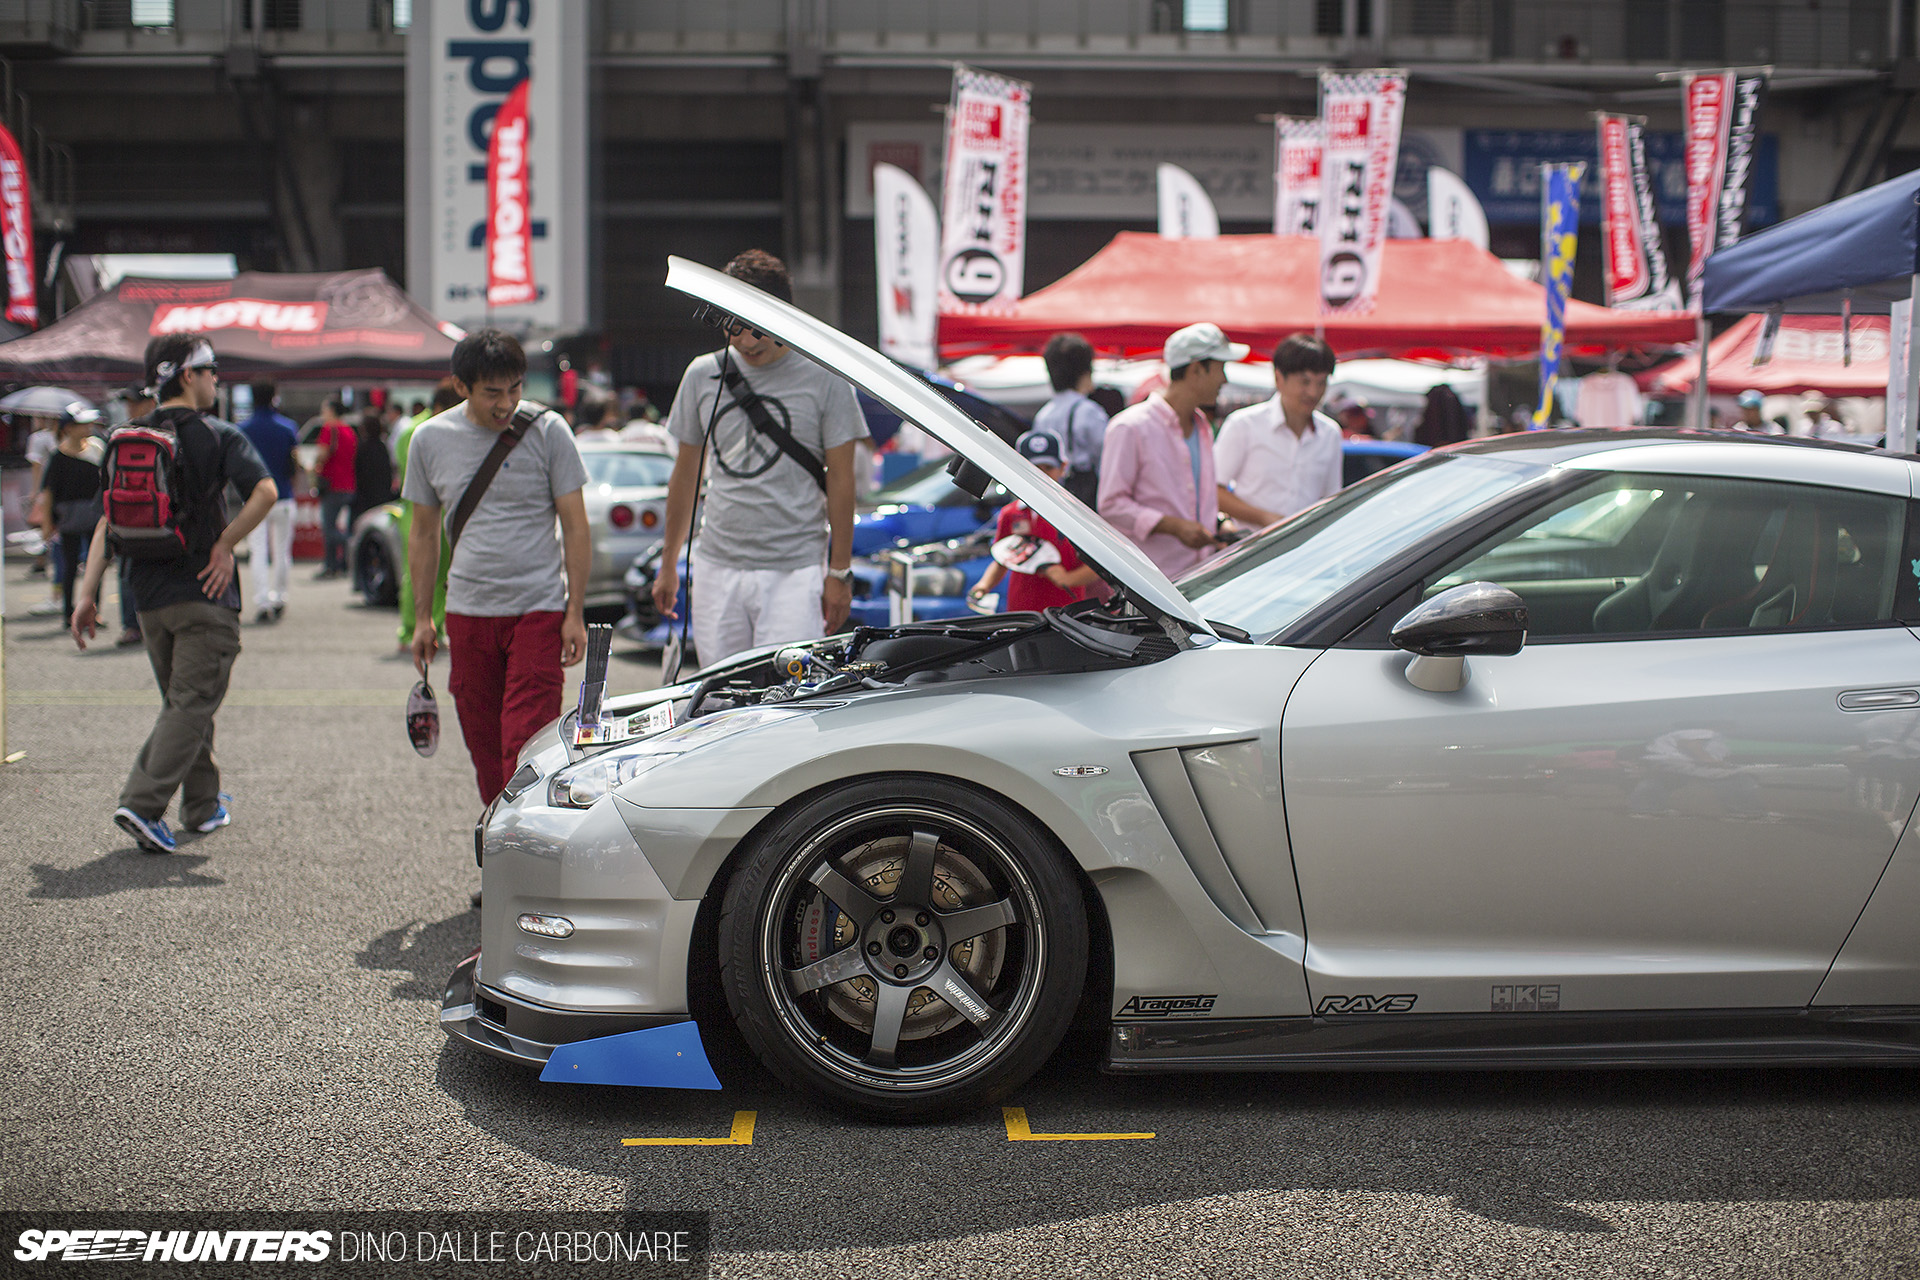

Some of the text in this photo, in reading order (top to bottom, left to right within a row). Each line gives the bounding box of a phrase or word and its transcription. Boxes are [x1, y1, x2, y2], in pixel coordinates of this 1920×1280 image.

[492, 117, 527, 282] MOTUL
[157, 301, 319, 333] MOTUL
[806, 907, 821, 960] ndless
[1115, 994, 1218, 1016] Aragosta
[1316, 994, 1418, 1013] RAYS
[1491, 985, 1560, 1005] HKS
